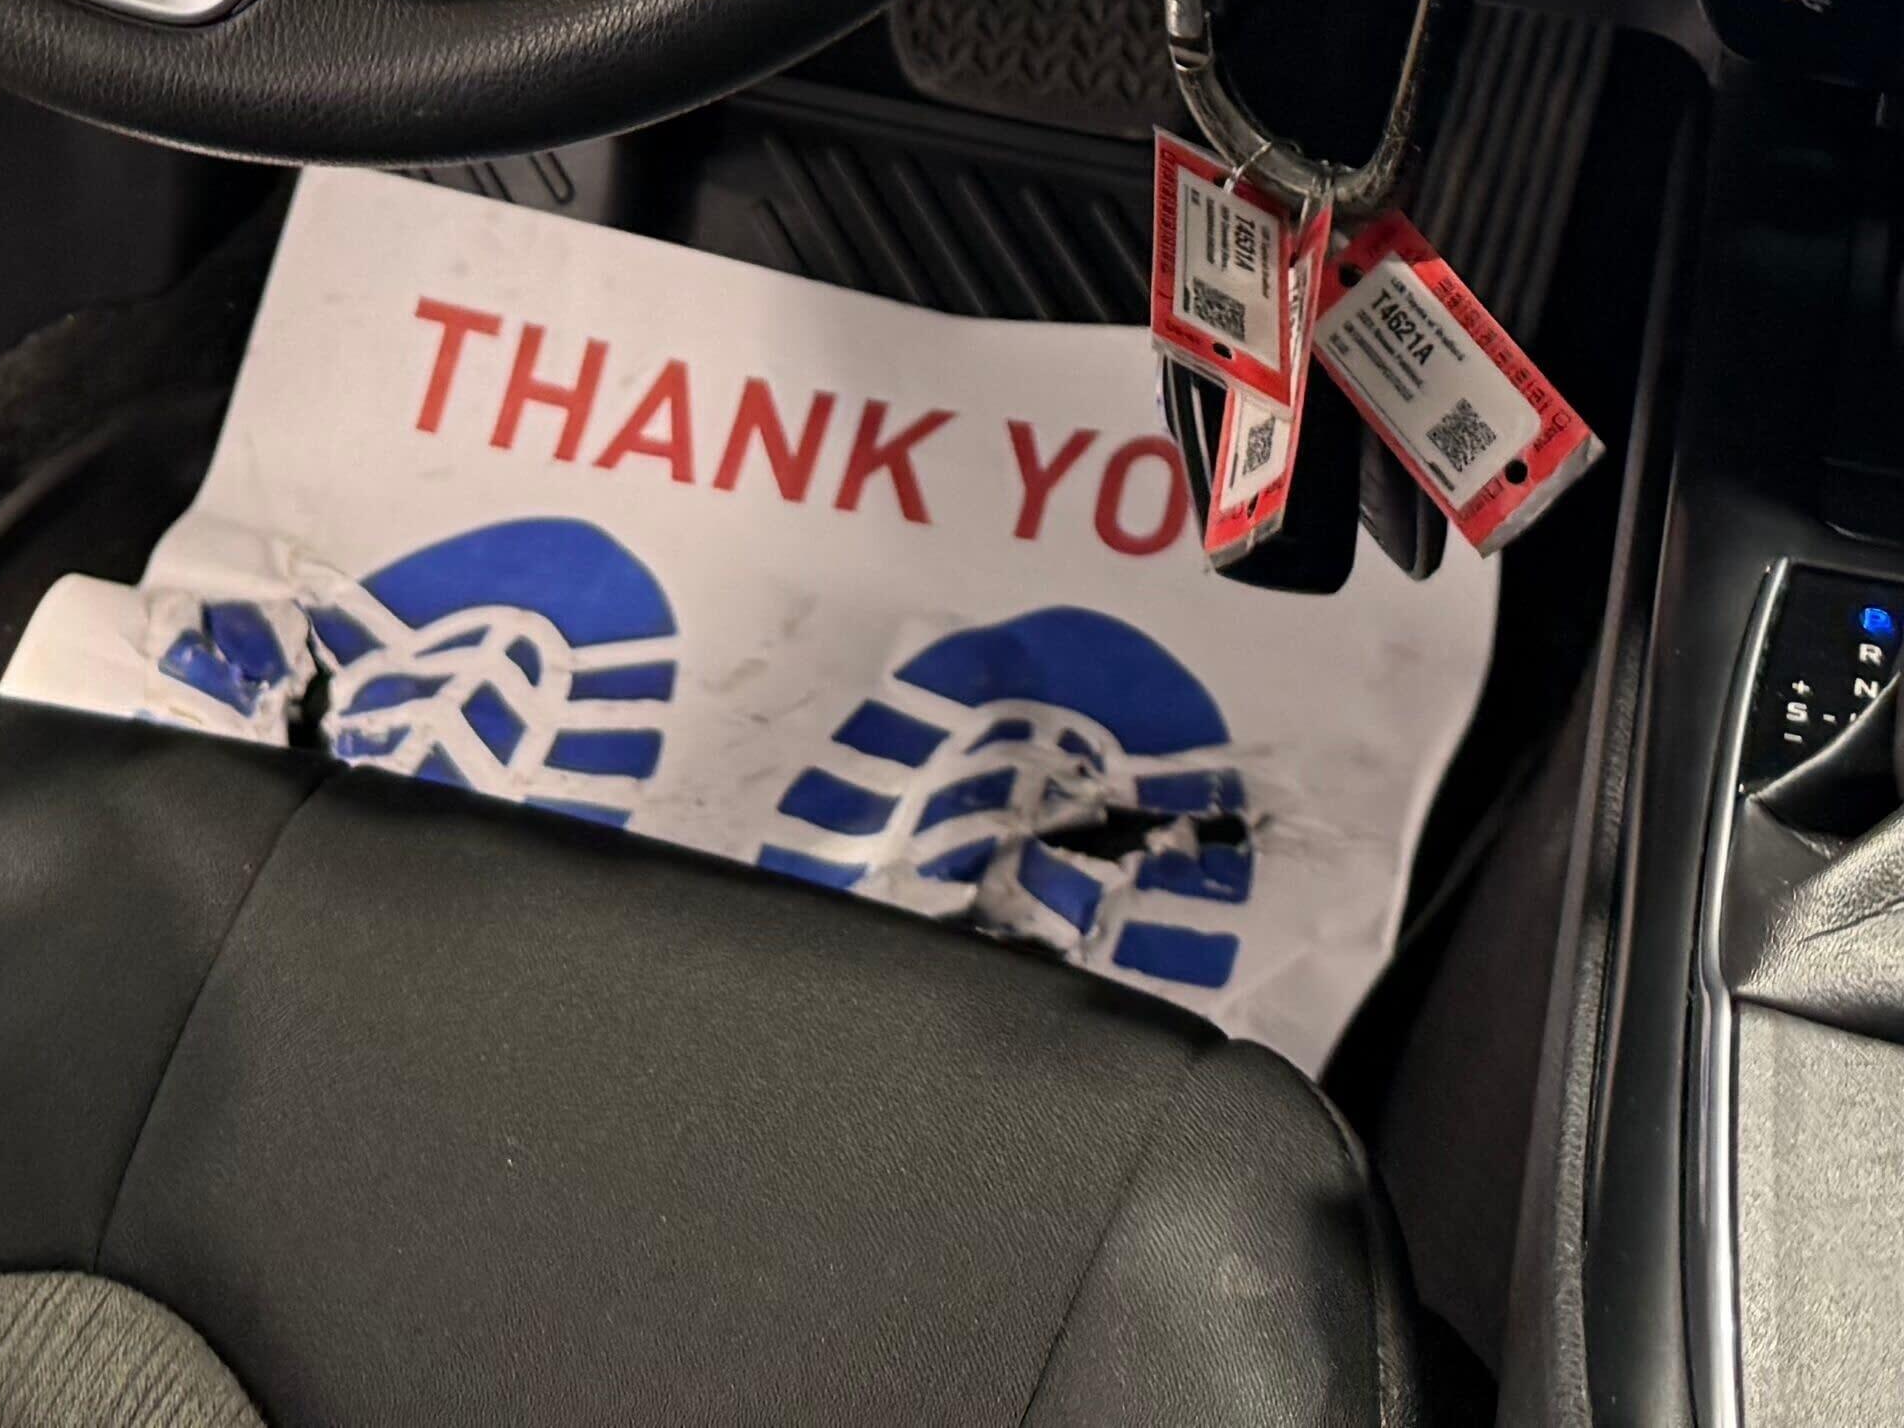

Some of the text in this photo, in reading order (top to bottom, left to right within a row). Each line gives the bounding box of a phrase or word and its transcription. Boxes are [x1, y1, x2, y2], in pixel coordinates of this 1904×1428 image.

[1366, 286, 1438, 367] T4621A
[413, 296, 1190, 558] THANK YO
[1862, 607, 1893, 634] P
[1858, 643, 1883, 667] R
[1853, 677, 1879, 699] N
[1786, 701, 1810, 723] S
